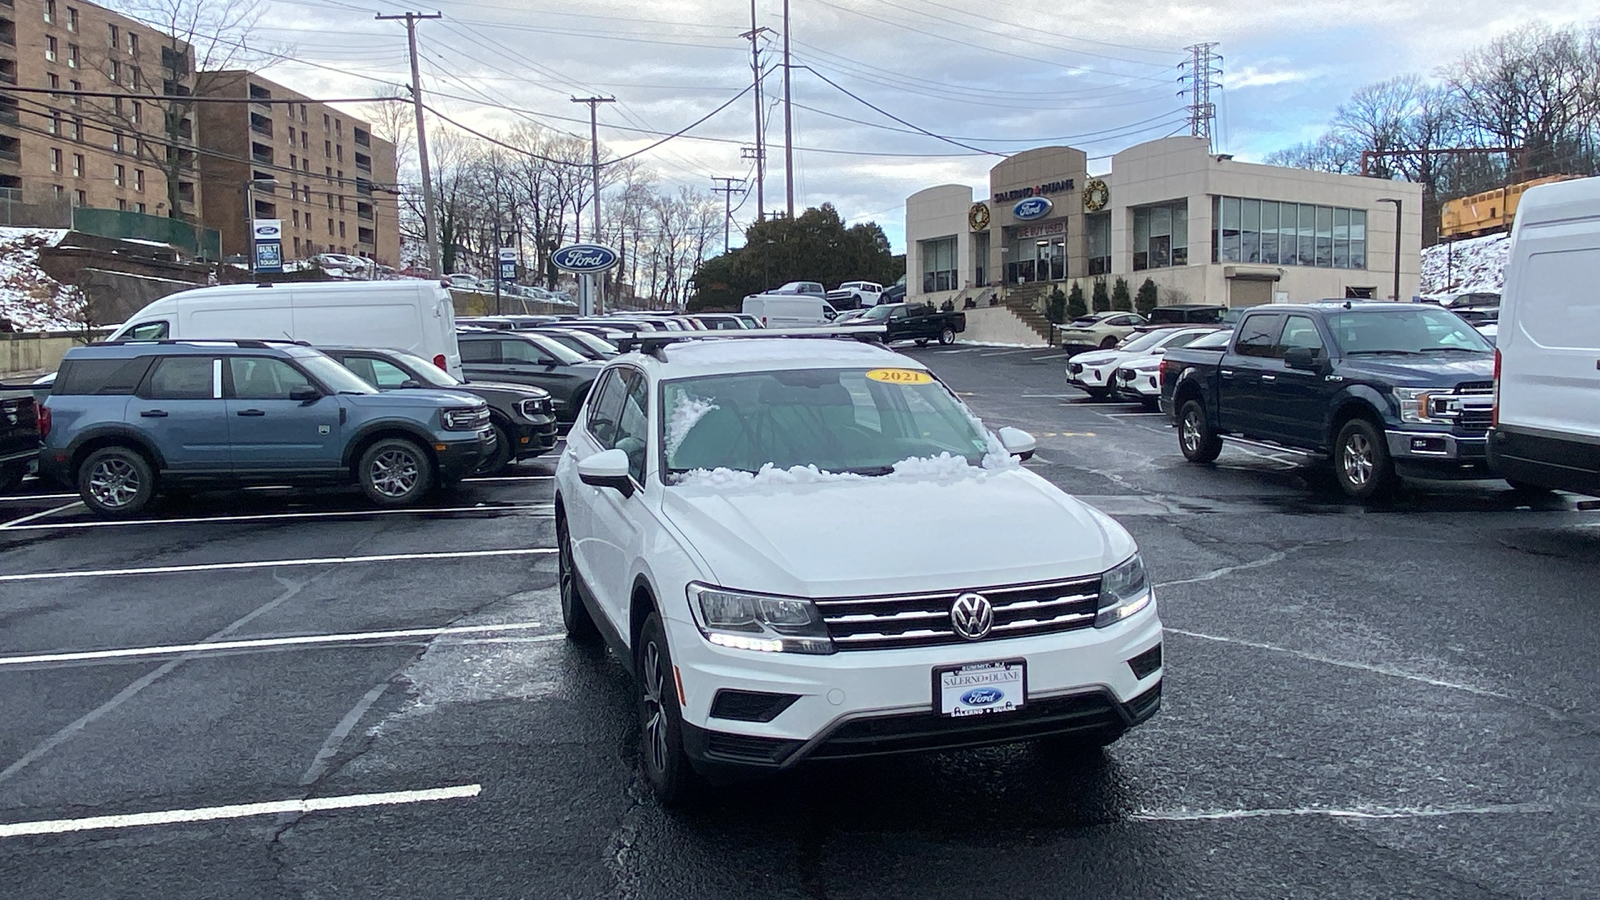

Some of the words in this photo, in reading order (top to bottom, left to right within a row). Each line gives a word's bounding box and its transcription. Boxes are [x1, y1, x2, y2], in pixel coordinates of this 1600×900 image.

[994, 187, 1033, 203] SALERNO
[1041, 179, 1074, 194] DUANE
[1020, 202, 1041, 216] Ford
[1030, 225, 1044, 237] BUY
[1045, 222, 1064, 234] USED
[565, 249, 603, 266] Ford
[880, 372, 919, 381] 2021
[944, 674, 984, 687] SALERNO
[989, 671, 1020, 682] DUANE
[969, 690, 995, 704] Ford
